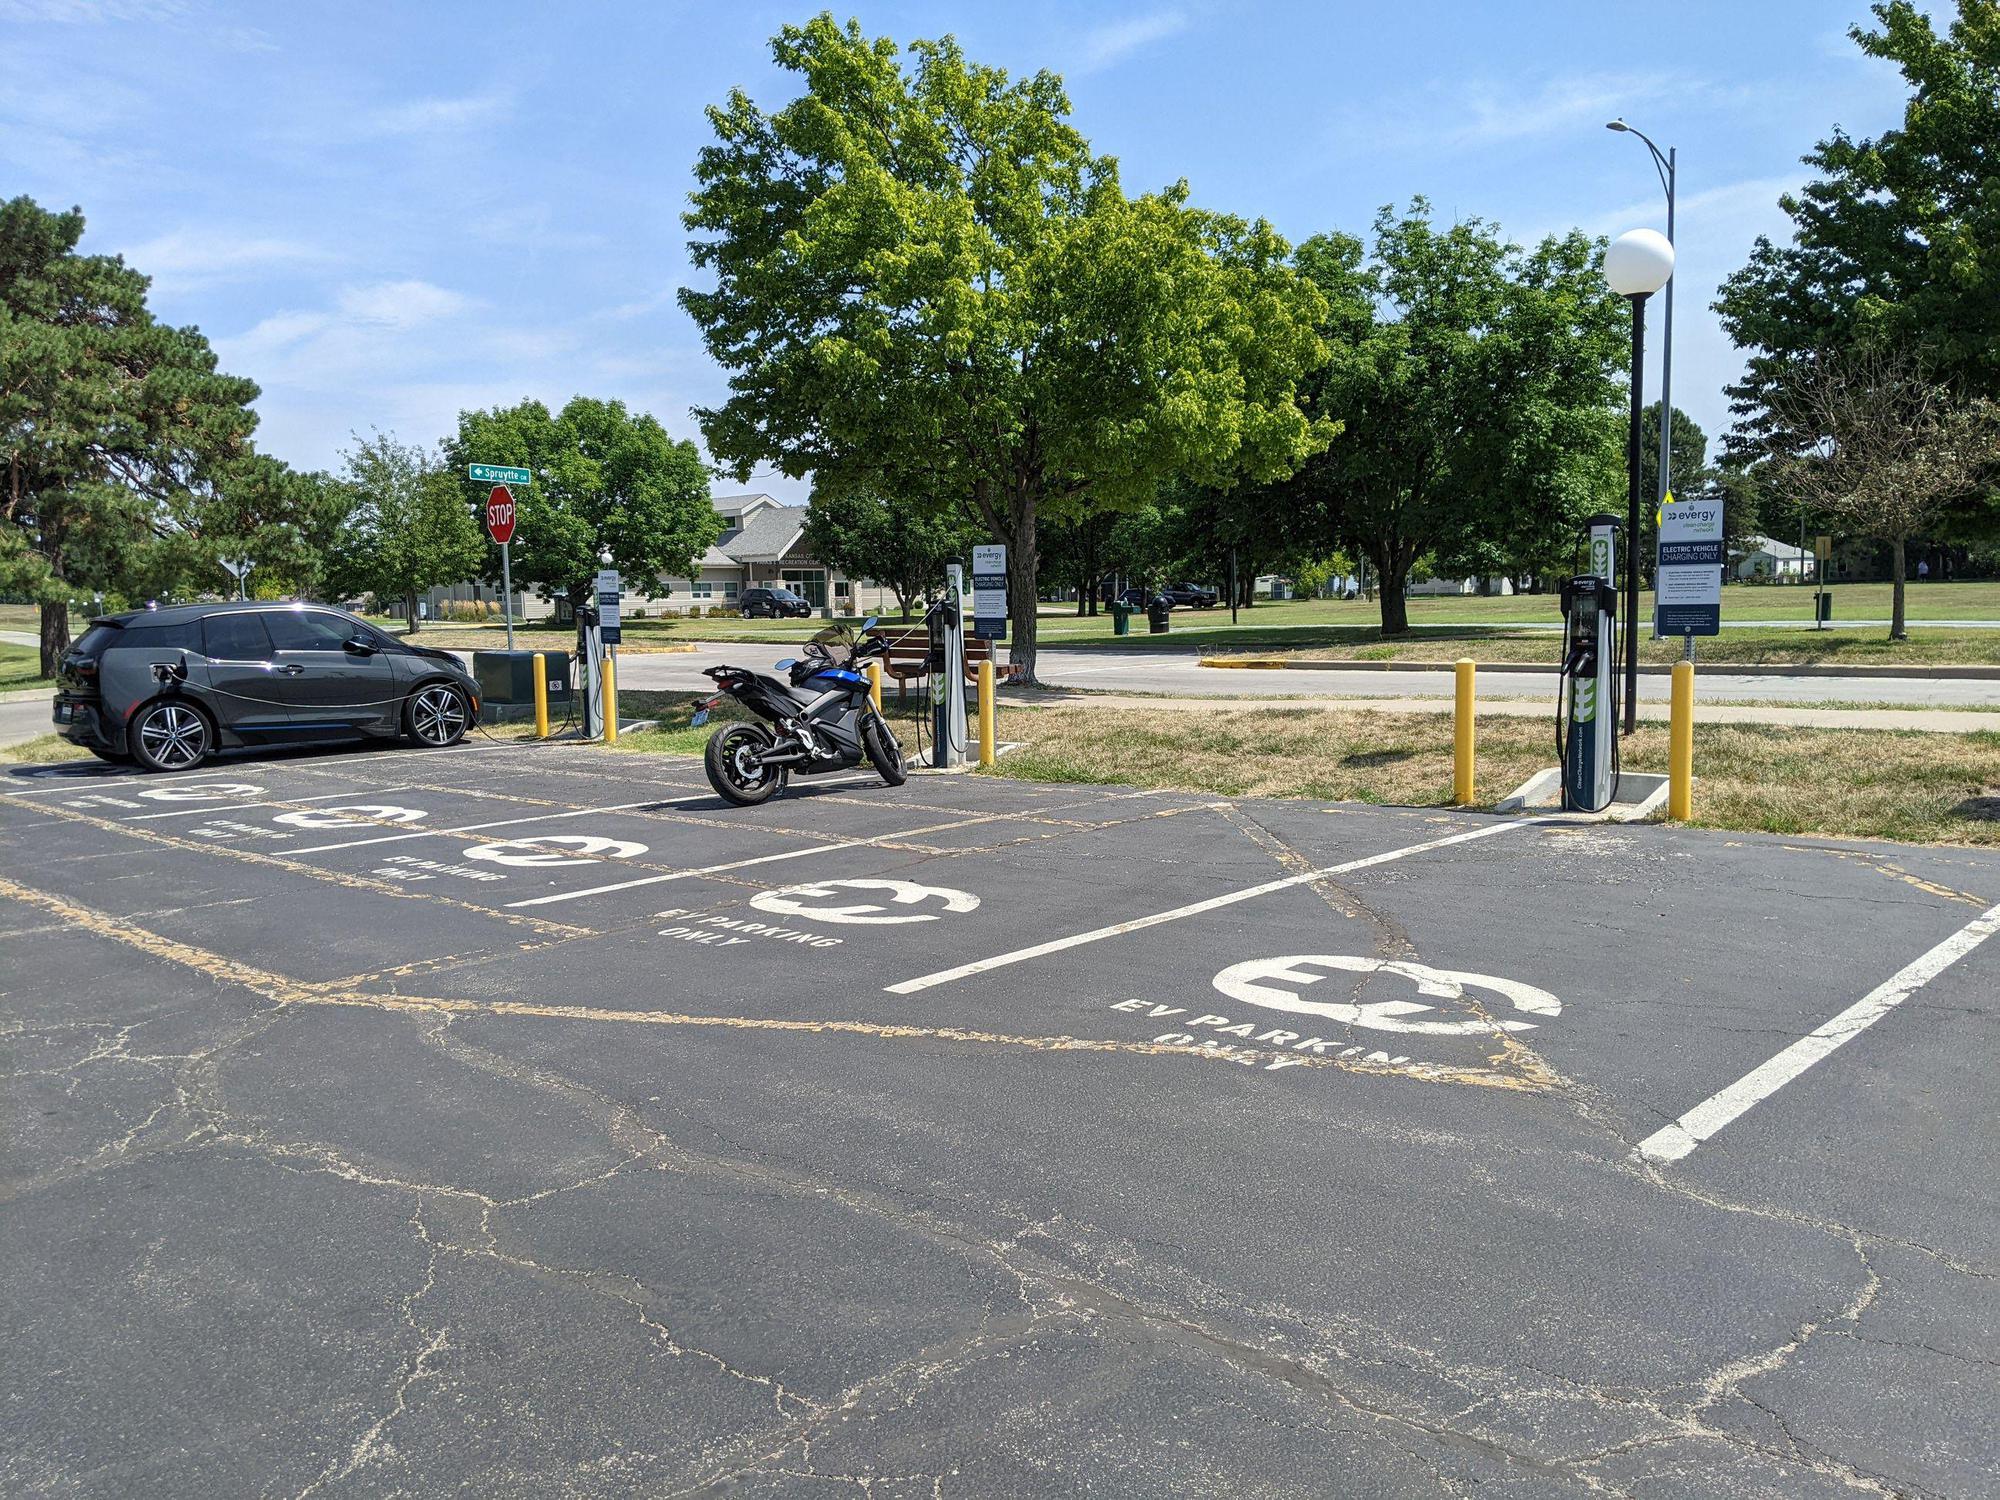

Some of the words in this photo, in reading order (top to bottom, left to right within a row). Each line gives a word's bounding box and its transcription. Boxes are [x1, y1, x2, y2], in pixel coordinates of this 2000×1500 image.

[485, 467, 519, 481] Spruytte
[489, 503, 513, 526] STOP
[1678, 510, 1716, 521] evergy
[1662, 552, 1698, 561] CHARGING
[1699, 551, 1718, 560] ONLY
[1692, 544, 1719, 552] VEHICLE
[657, 927, 752, 947] ONLY
[695, 915, 844, 948] PARKING
[1108, 997, 1189, 1018] EV
[1184, 1013, 1428, 1070] PARKIN
